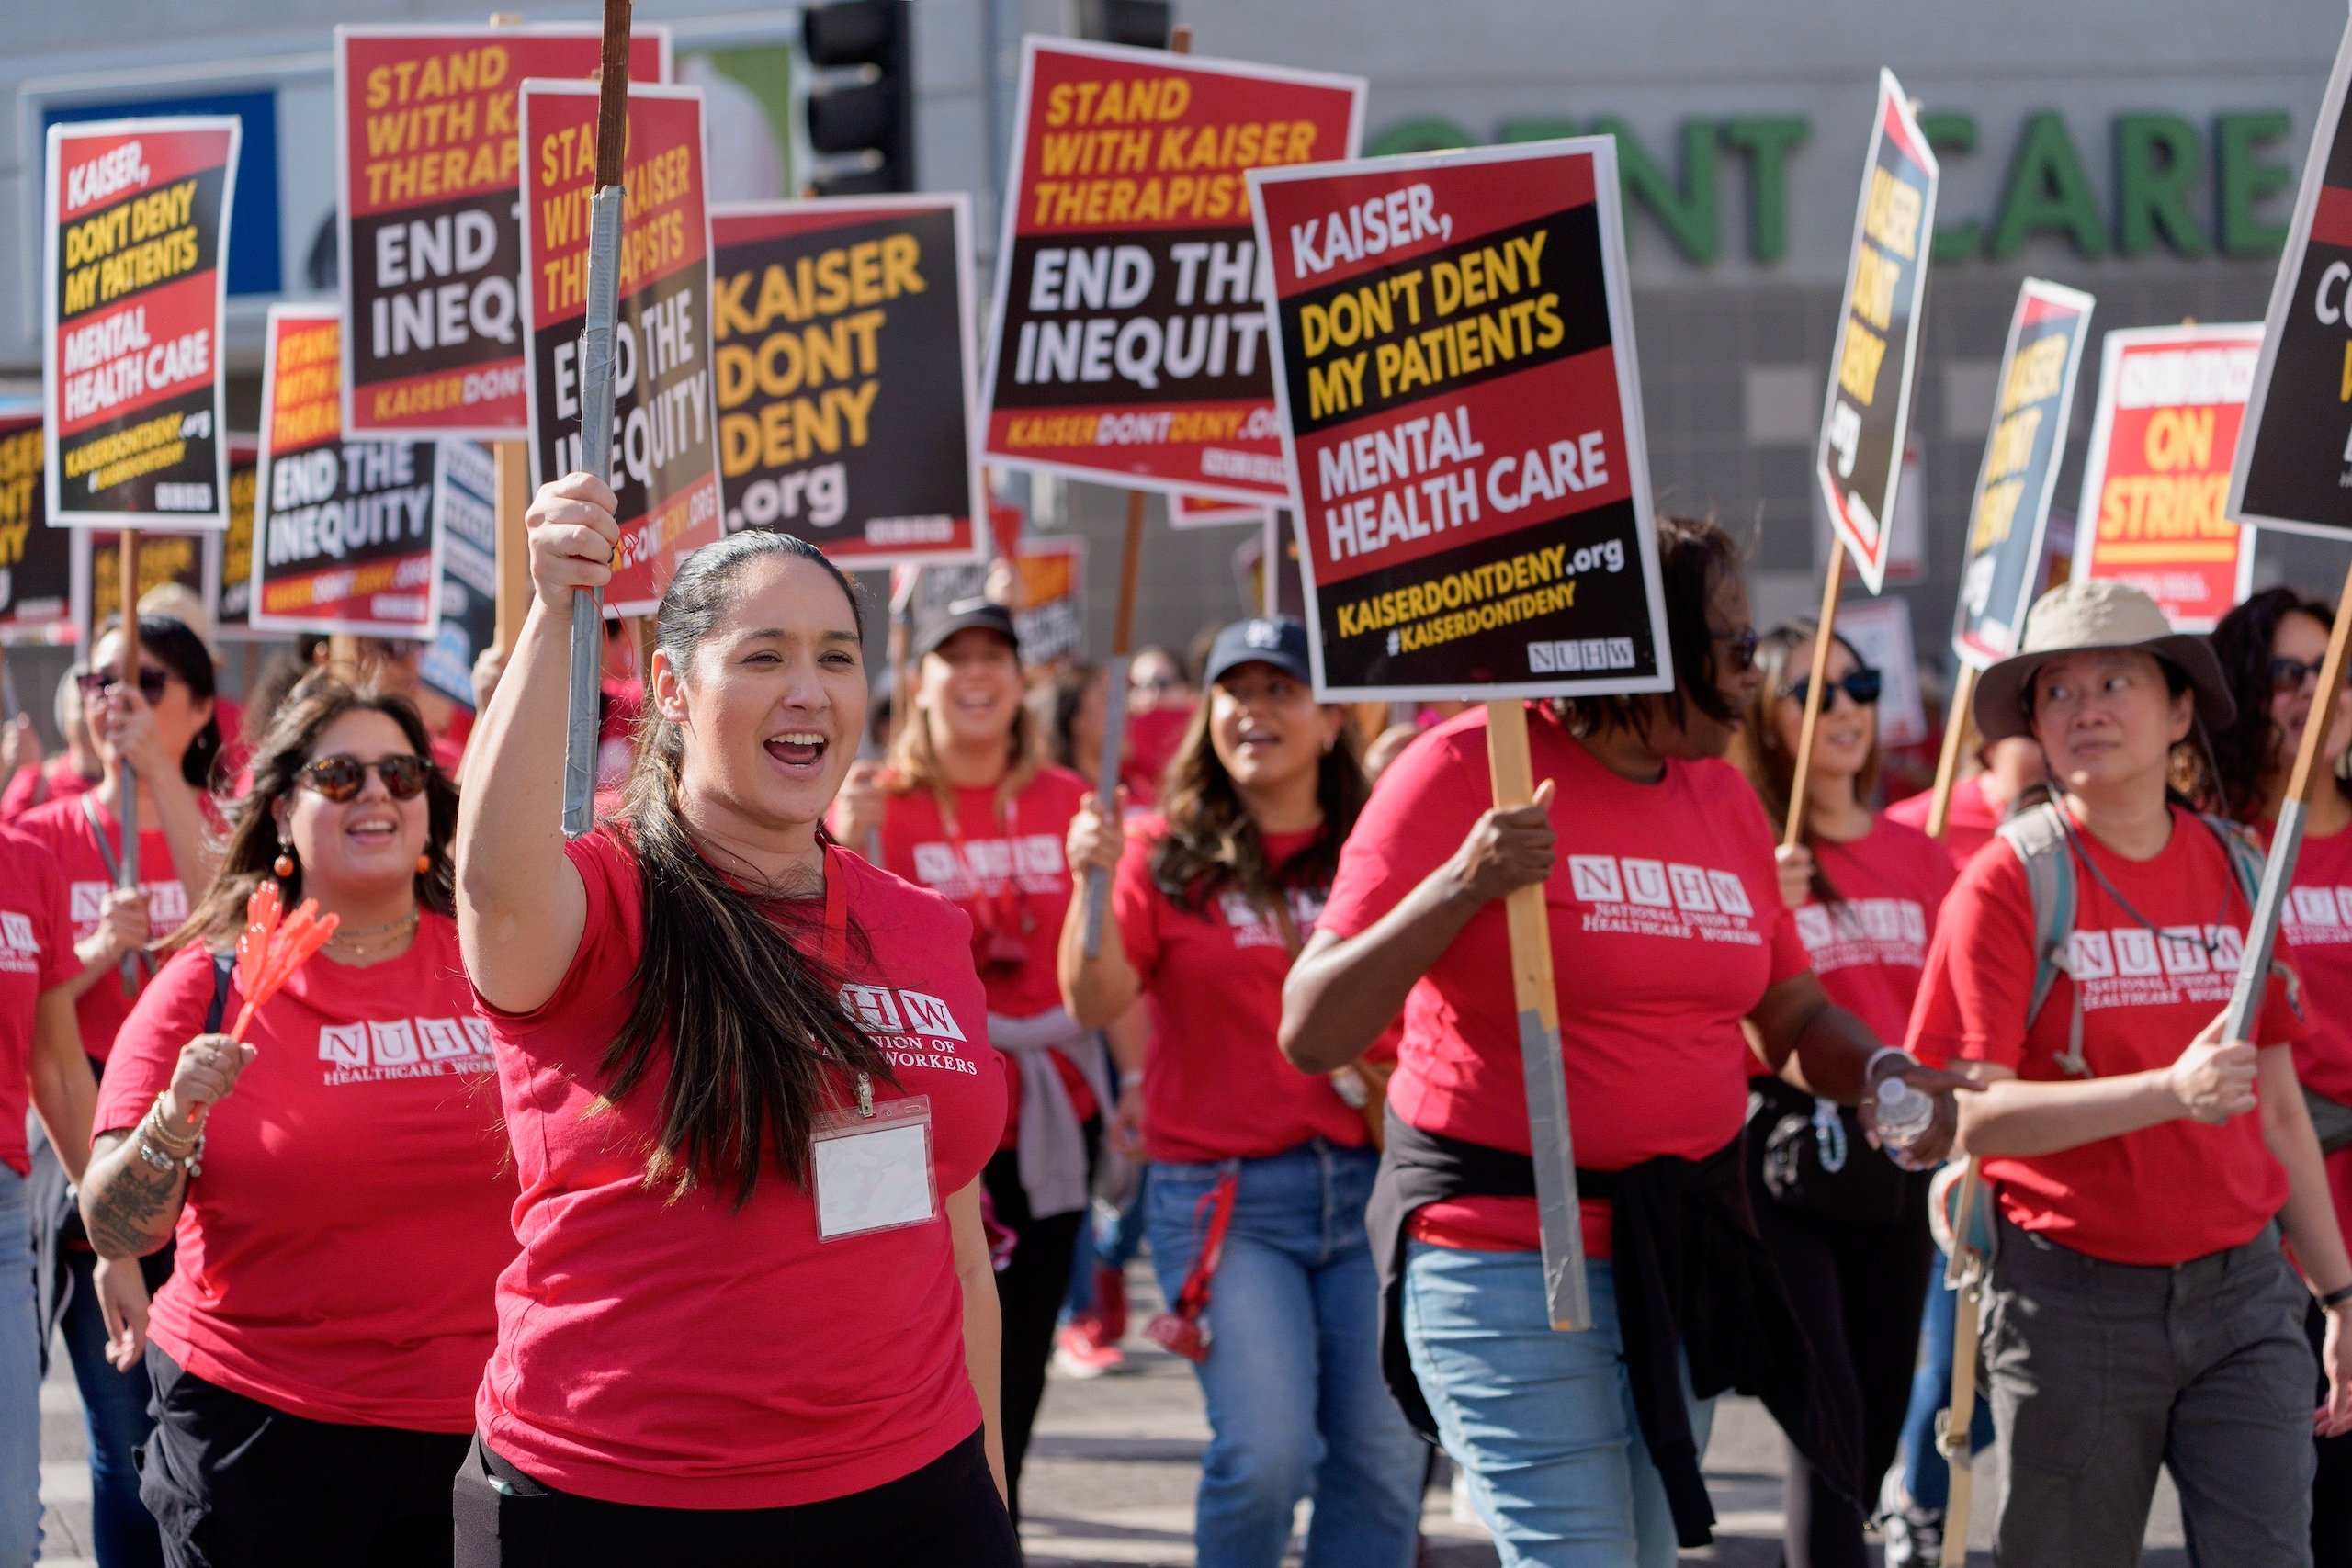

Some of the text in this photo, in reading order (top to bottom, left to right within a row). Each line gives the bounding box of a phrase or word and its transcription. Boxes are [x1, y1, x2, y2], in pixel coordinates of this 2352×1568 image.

[367, 44, 509, 109] STAND
[1045, 76, 1193, 128] STAND
[366, 97, 478, 157] WITH
[1040, 119, 1319, 177] WITH KAISER
[67, 140, 151, 212] KAISER,
[364, 136, 520, 207] THERAP
[1033, 175, 1251, 227] THERAPIST
[66, 179, 198, 270] DON'T DENY
[375, 208, 499, 289] END
[543, 185, 594, 251] WIT
[1289, 182, 1453, 280] KAISER,
[64, 224, 199, 316] MY PATIENTS
[713, 232, 929, 343] KAISER
[1028, 239, 1268, 313] END TH
[1298, 228, 1549, 359] DON'T DENY
[64, 304, 151, 377] MENTAL
[371, 274, 523, 360] INEQ
[1013, 310, 1268, 390] INEQUIT
[64, 327, 210, 423] HEALTH CARE
[553, 288, 695, 421] ED THE
[714, 308, 887, 411] DONT
[1306, 291, 1566, 421] MY PATIENTS
[718, 378, 880, 479] DENY
[1317, 403, 1486, 502] MENTAL
[2143, 405, 2217, 474] ON
[272, 447, 338, 513] END
[343, 438, 416, 495] THE
[726, 461, 849, 533] .org
[1325, 429, 1611, 562] HEALTH CARE
[266, 482, 432, 568] INEQUITY
[1336, 537, 1624, 639] KAISERDONTDENY.org
[1385, 580, 1578, 658] #KAISERDONTDENY
[1527, 637, 1635, 673] NUHW
[1567, 853, 1756, 919] NUHW
[1581, 913, 1694, 940] HEALTHCARE
[837, 983, 967, 1042] HW
[868, 1035, 955, 1054] NION OF
[323, 1061, 443, 1087] HEALTHCARE
[879, 1051, 978, 1076] WORKERS
